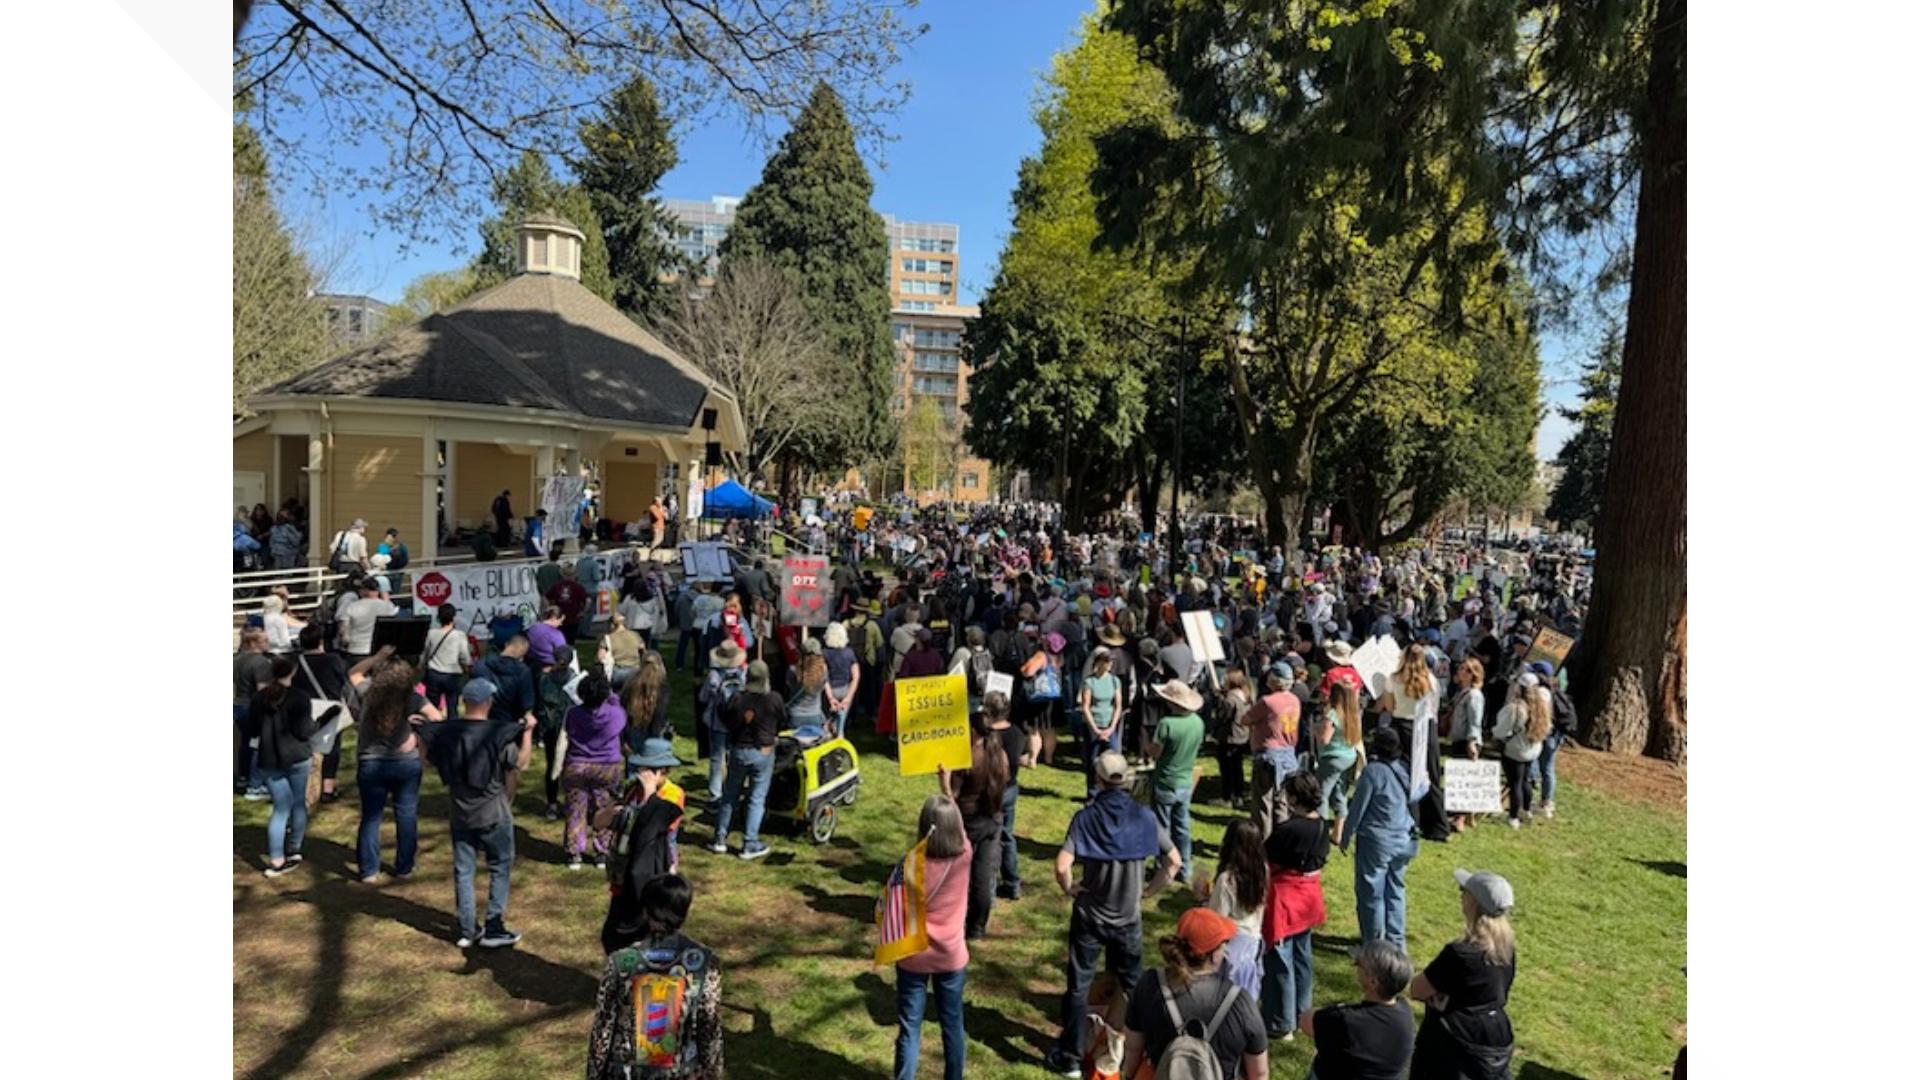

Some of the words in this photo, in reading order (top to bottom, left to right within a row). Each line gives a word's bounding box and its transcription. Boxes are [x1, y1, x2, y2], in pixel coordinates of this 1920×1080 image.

[421, 582, 449, 597] STOP
[459, 581, 481, 600] the
[909, 692, 954, 711] ISSUES
[902, 726, 965, 744] CARDBOARD
